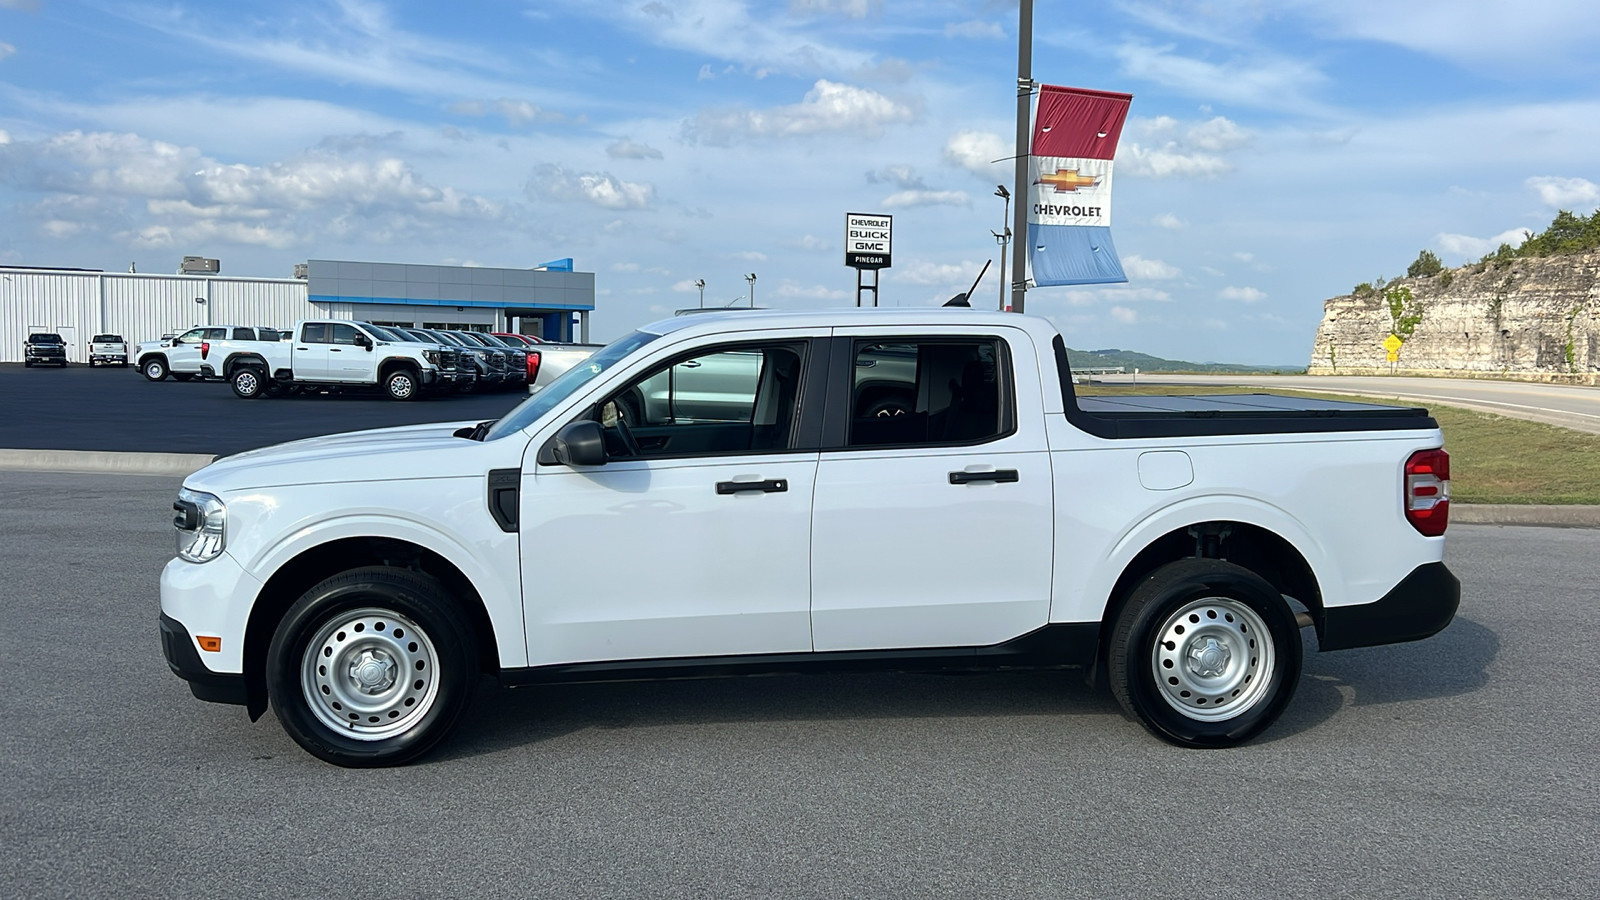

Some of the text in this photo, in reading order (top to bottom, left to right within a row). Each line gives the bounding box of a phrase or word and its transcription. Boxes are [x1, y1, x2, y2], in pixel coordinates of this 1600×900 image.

[1034, 204, 1101, 217] CHEVROLET
[851, 219, 889, 227] CHEVROLET
[850, 231, 888, 239] BUICK
[855, 242, 884, 250] GMC
